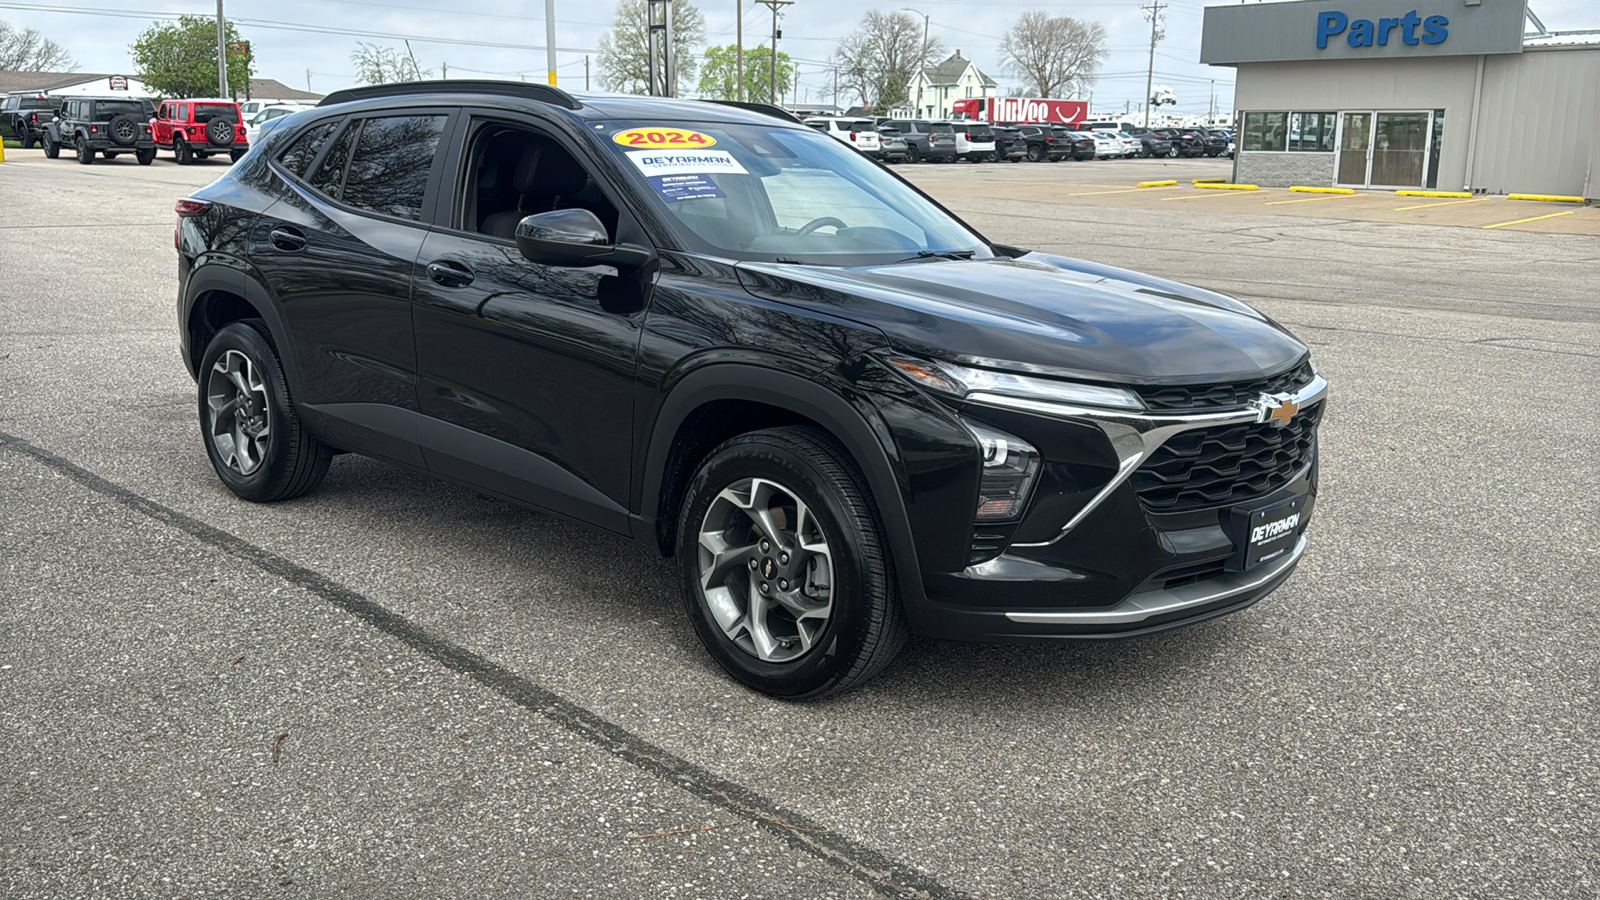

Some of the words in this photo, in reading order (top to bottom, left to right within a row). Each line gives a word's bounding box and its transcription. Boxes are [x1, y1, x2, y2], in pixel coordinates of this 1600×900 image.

[1316, 10, 1449, 49] Parts
[626, 132, 708, 145] 2024
[642, 156, 731, 165] DEYARMAN
[1251, 512, 1300, 543] DEYARMAN
